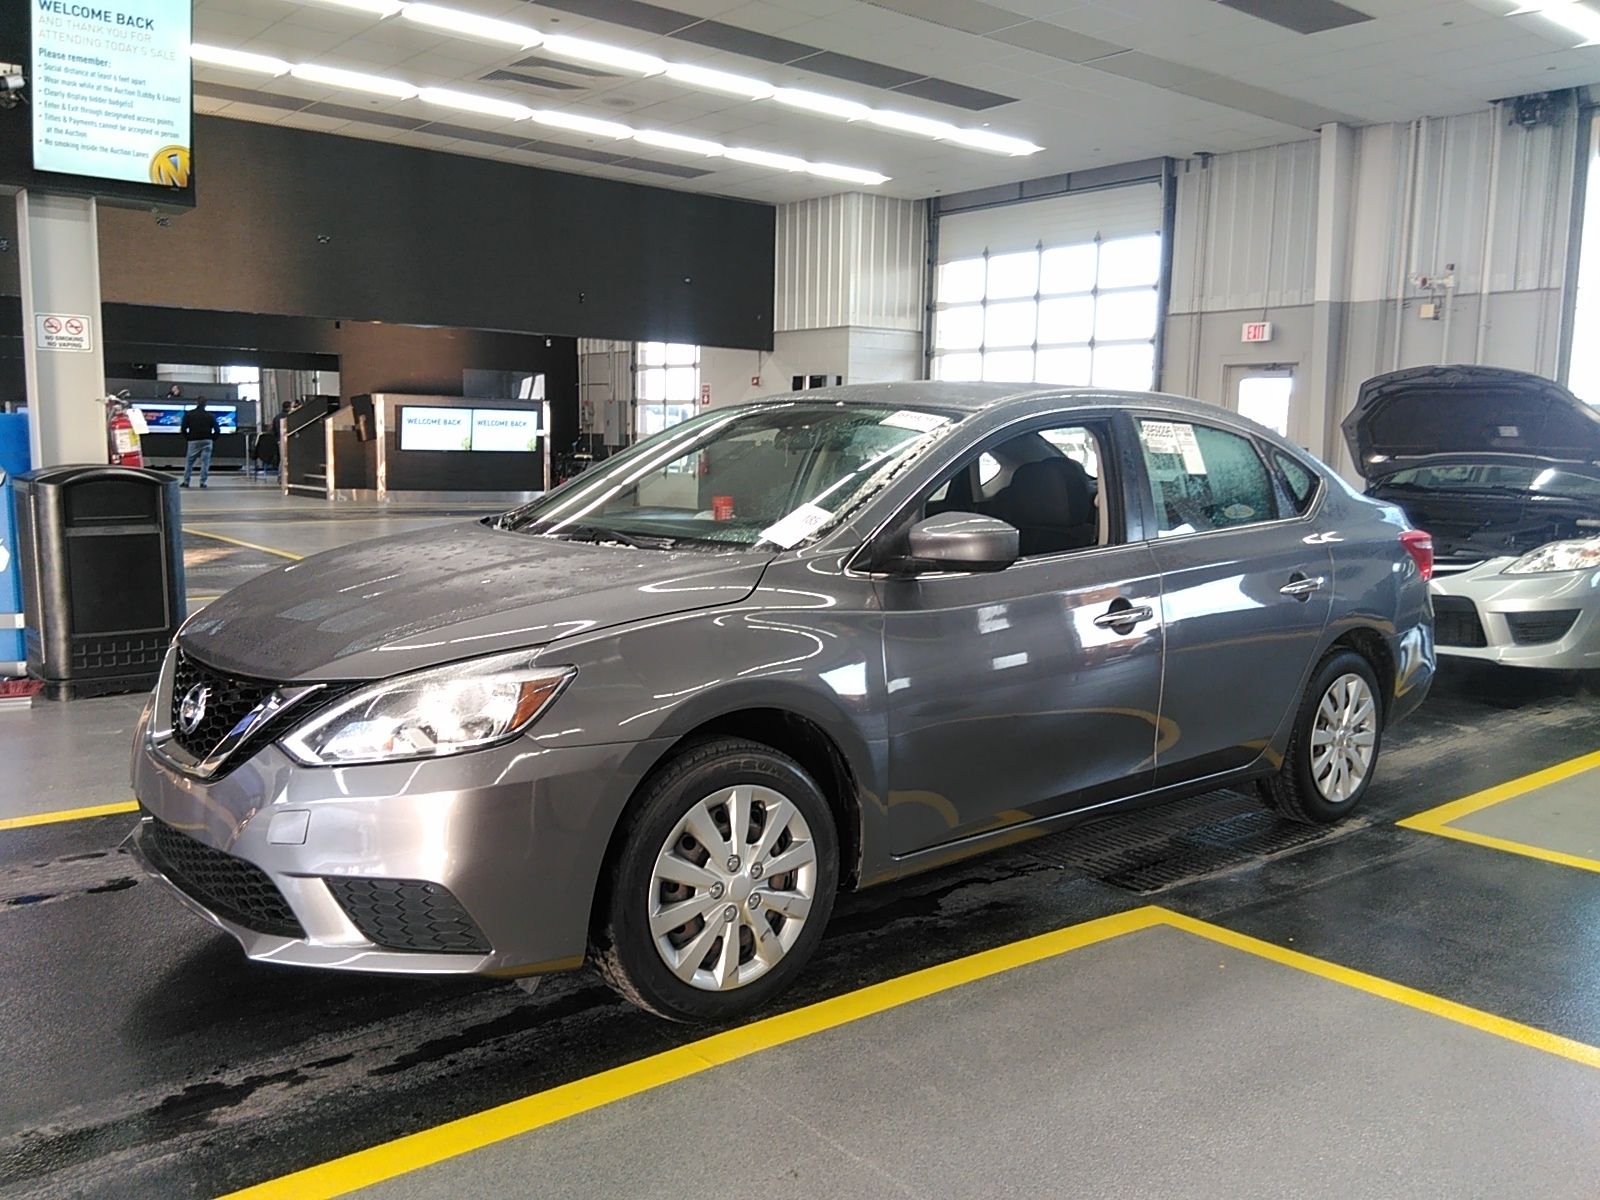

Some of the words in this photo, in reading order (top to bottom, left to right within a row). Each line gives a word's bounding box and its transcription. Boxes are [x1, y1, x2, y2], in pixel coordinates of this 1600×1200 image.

[39, 0, 112, 22] WELCOME
[116, 13, 154, 30] BACK
[38, 16, 62, 27] AND
[66, 20, 103, 34] THANK
[106, 28, 127, 39] YOU
[131, 31, 151, 43] FOR
[38, 30, 101, 48] ATTENDING
[150, 48, 176, 61] SALE
[39, 48, 66, 60] Please
[68, 54, 111, 68] remember:
[44, 63, 61, 72] Social
[64, 67, 89, 76] distance
[97, 72, 112, 80] least
[118, 75, 130, 83] feet
[131, 78, 146, 86] apart
[44, 76, 60, 84] Wear
[114, 87, 136, 96] Auction
[44, 88, 65, 99] Clearly
[67, 92, 87, 102] display
[89, 96, 107, 104] bidder
[44, 100, 60, 109] Enter
[81, 106, 102, 117] through
[104, 110, 135, 120] designated
[137, 115, 156, 124] access
[157, 119, 174, 127] points
[44, 113, 61, 122] Titles
[69, 117, 97, 127] Payments
[128, 126, 153, 135] accepted
[65, 129, 87, 137] Auction
[45, 138, 53, 146] No
[54, 140, 79, 151] smoking
[110, 147, 131, 155] Auction
[133, 150, 149, 158] Lanes
[1248, 324, 1265, 340] EXIT
[407, 418, 441, 426] WELCOME
